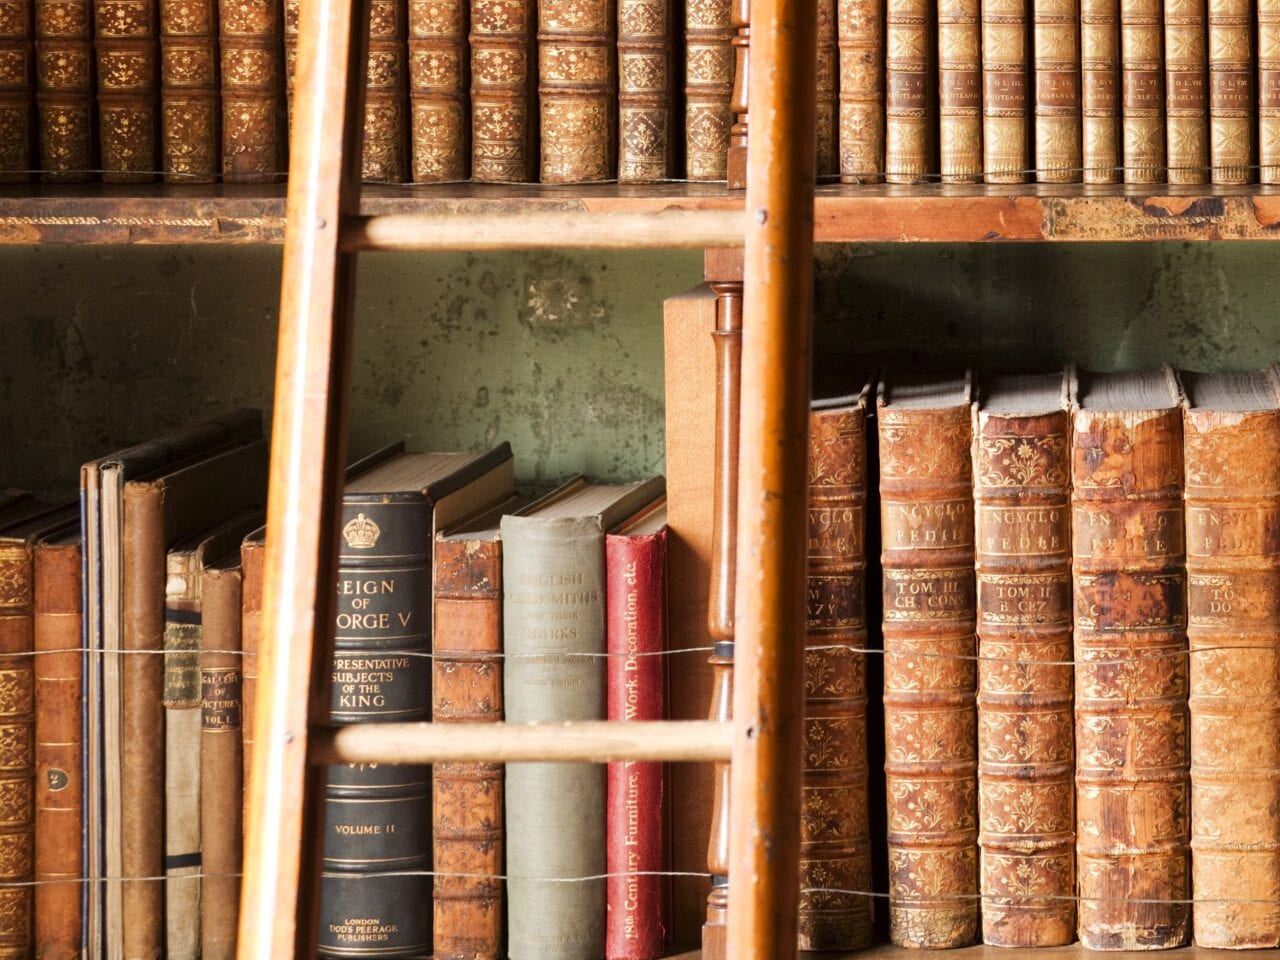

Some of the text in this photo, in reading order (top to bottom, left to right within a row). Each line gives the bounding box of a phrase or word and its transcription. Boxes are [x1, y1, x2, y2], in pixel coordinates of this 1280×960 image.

[888, 503, 966, 519] ENCYCLO
[809, 511, 853, 524] YCLO
[984, 511, 1060, 524] ENCYCLO
[987, 536, 1060, 550] PEDIE
[352, 598, 370, 609] OF
[336, 612, 412, 629] ORGE V
[334, 657, 409, 670] RESENTATIVE
[202, 673, 237, 684] GALLERY
[332, 672, 393, 683] SUBJECTS
[342, 685, 380, 694] OF THE
[340, 695, 385, 707] KING
[51, 773, 59, 785] 2
[624, 771, 641, 846] Furniture,
[335, 824, 395, 834] VOLUME II
[624, 851, 641, 910] Century
[345, 918, 380, 926] LONDON
[624, 916, 638, 939] 18th
[330, 924, 398, 933] DOD'S PEERAGE
[337, 933, 388, 941] PUBLISHERS
